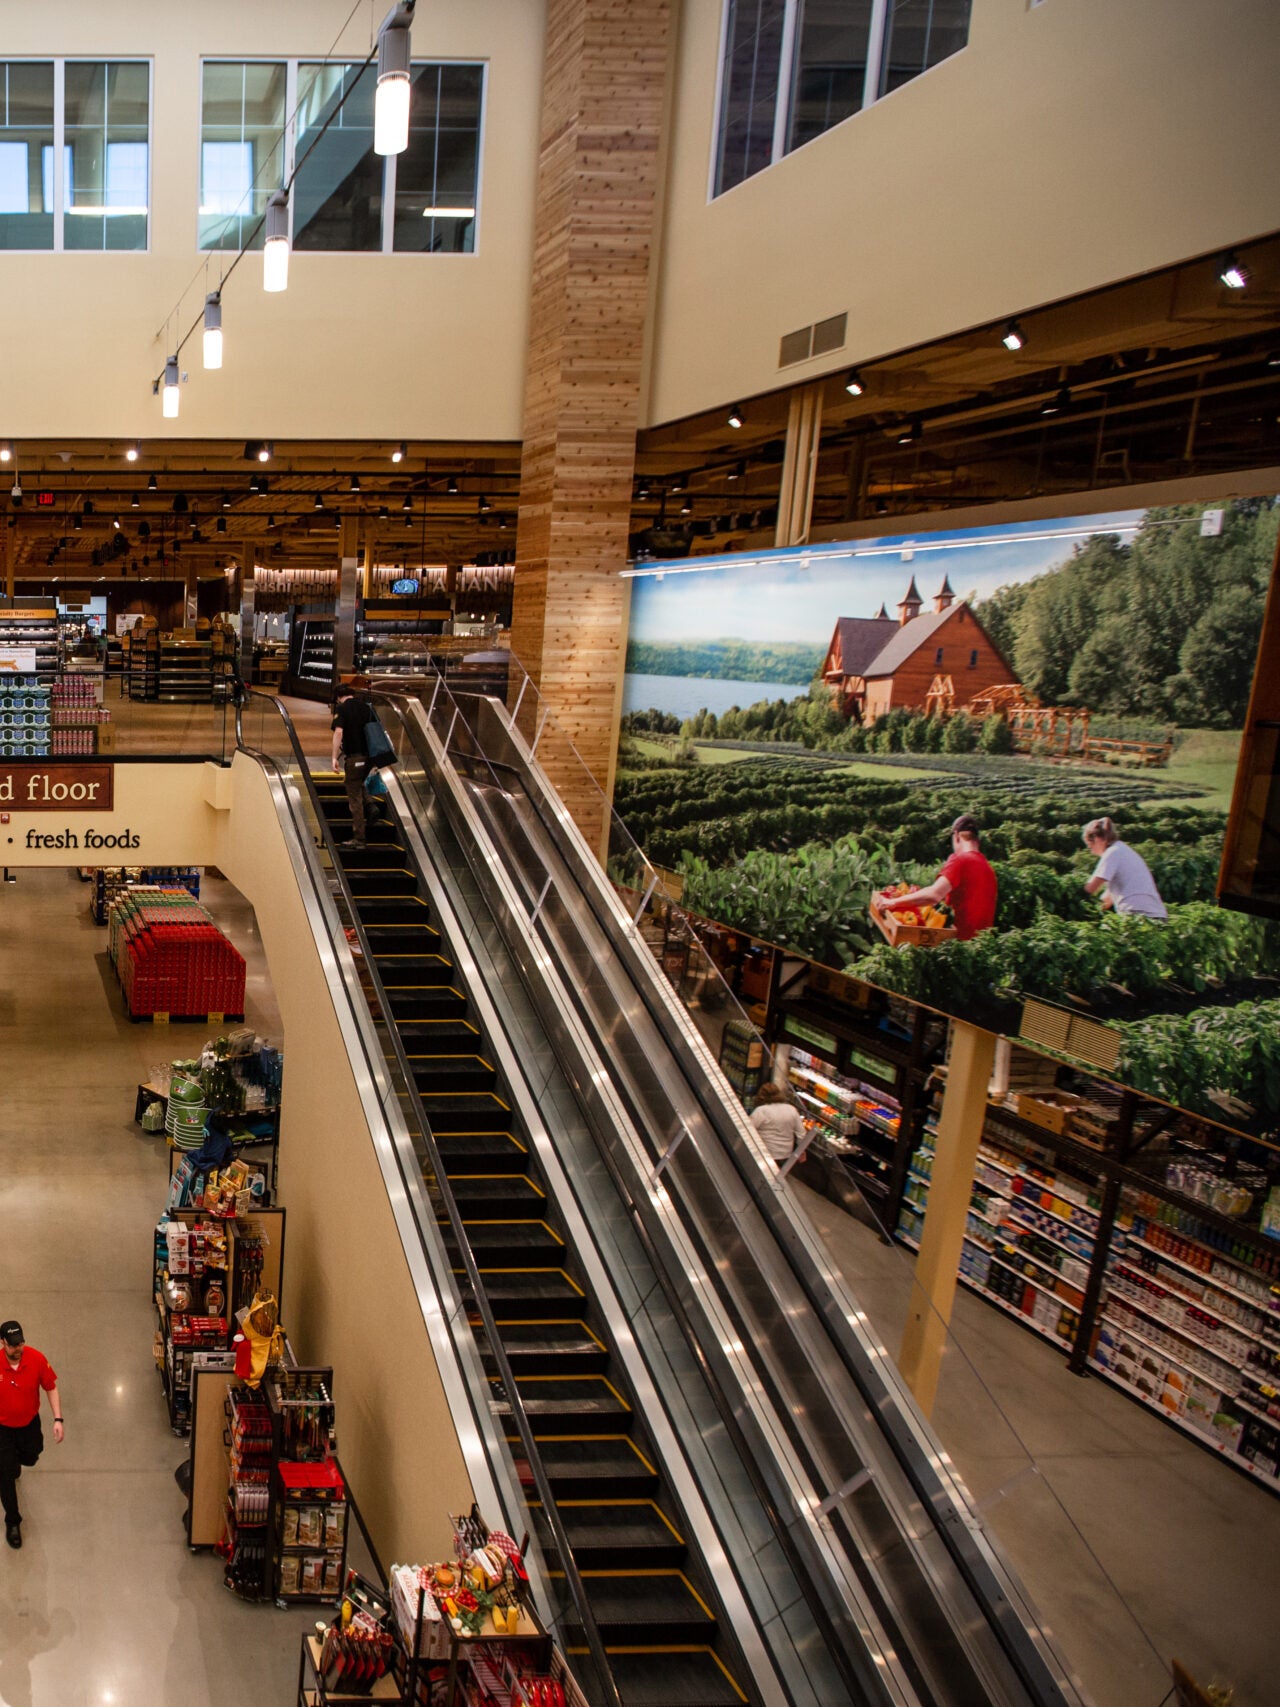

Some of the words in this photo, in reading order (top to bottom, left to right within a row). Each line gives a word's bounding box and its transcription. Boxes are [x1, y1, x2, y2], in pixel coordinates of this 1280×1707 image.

[39, 493, 53, 504] EXIT
[432, 576, 497, 592] AIAN
[27, 775, 100, 801] floor
[26, 829, 78, 849] fresh
[83, 829, 140, 849] foods
